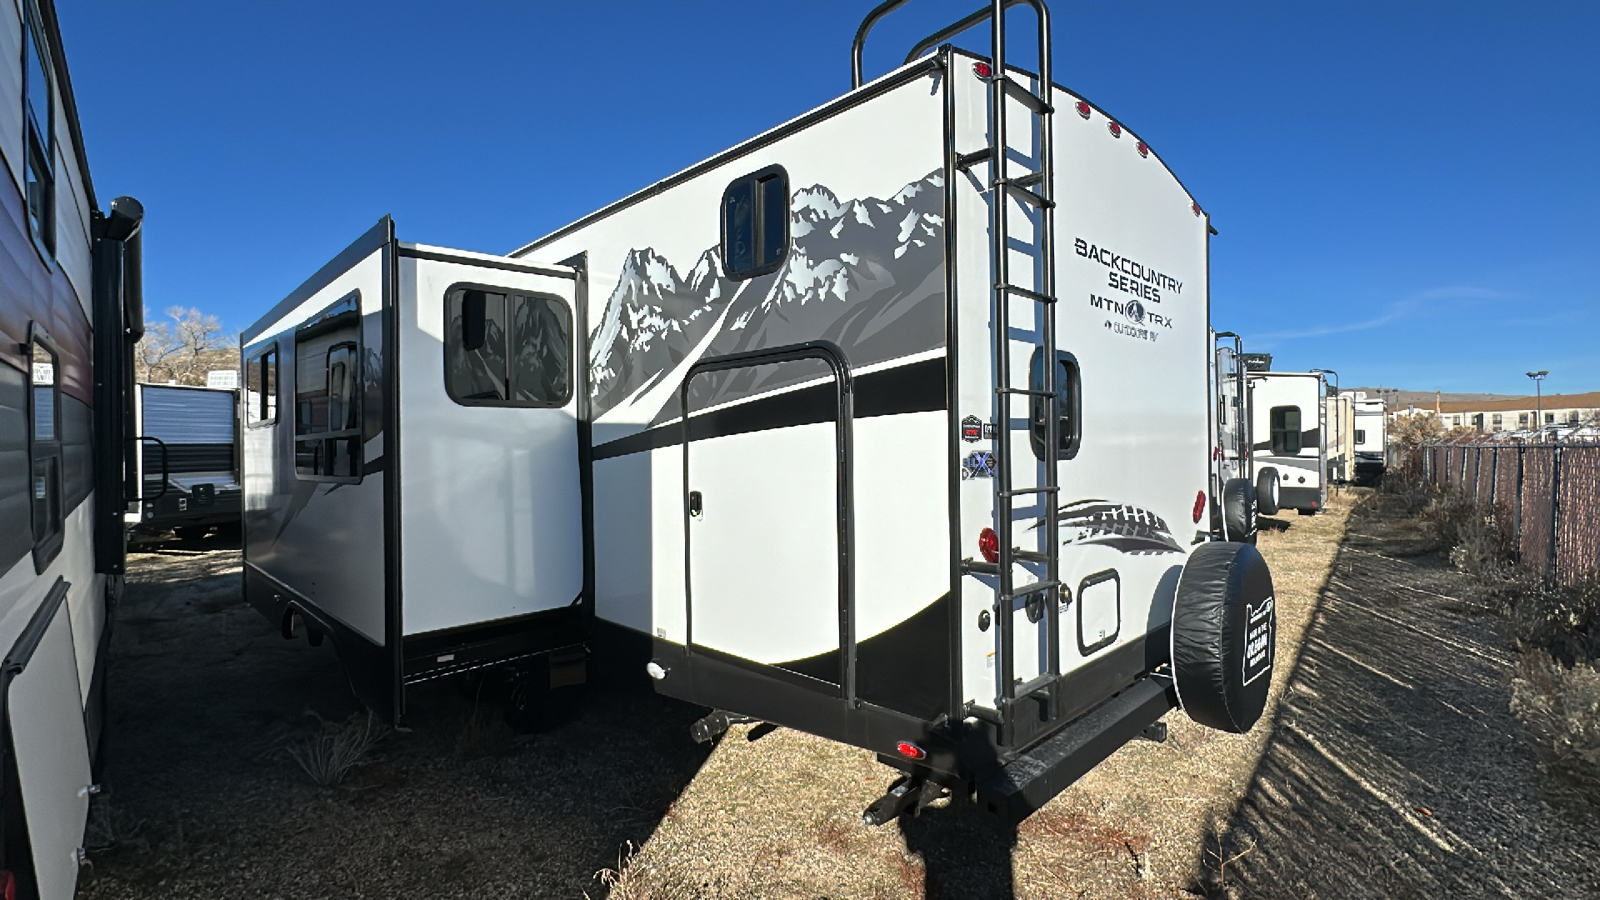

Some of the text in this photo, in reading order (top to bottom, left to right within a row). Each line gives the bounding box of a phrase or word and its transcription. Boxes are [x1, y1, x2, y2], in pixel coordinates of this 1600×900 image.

[1075, 236, 1183, 294] BACKCOUNTRY
[1108, 271, 1161, 303] SERIES
[1090, 293, 1173, 329] MTN TRX
